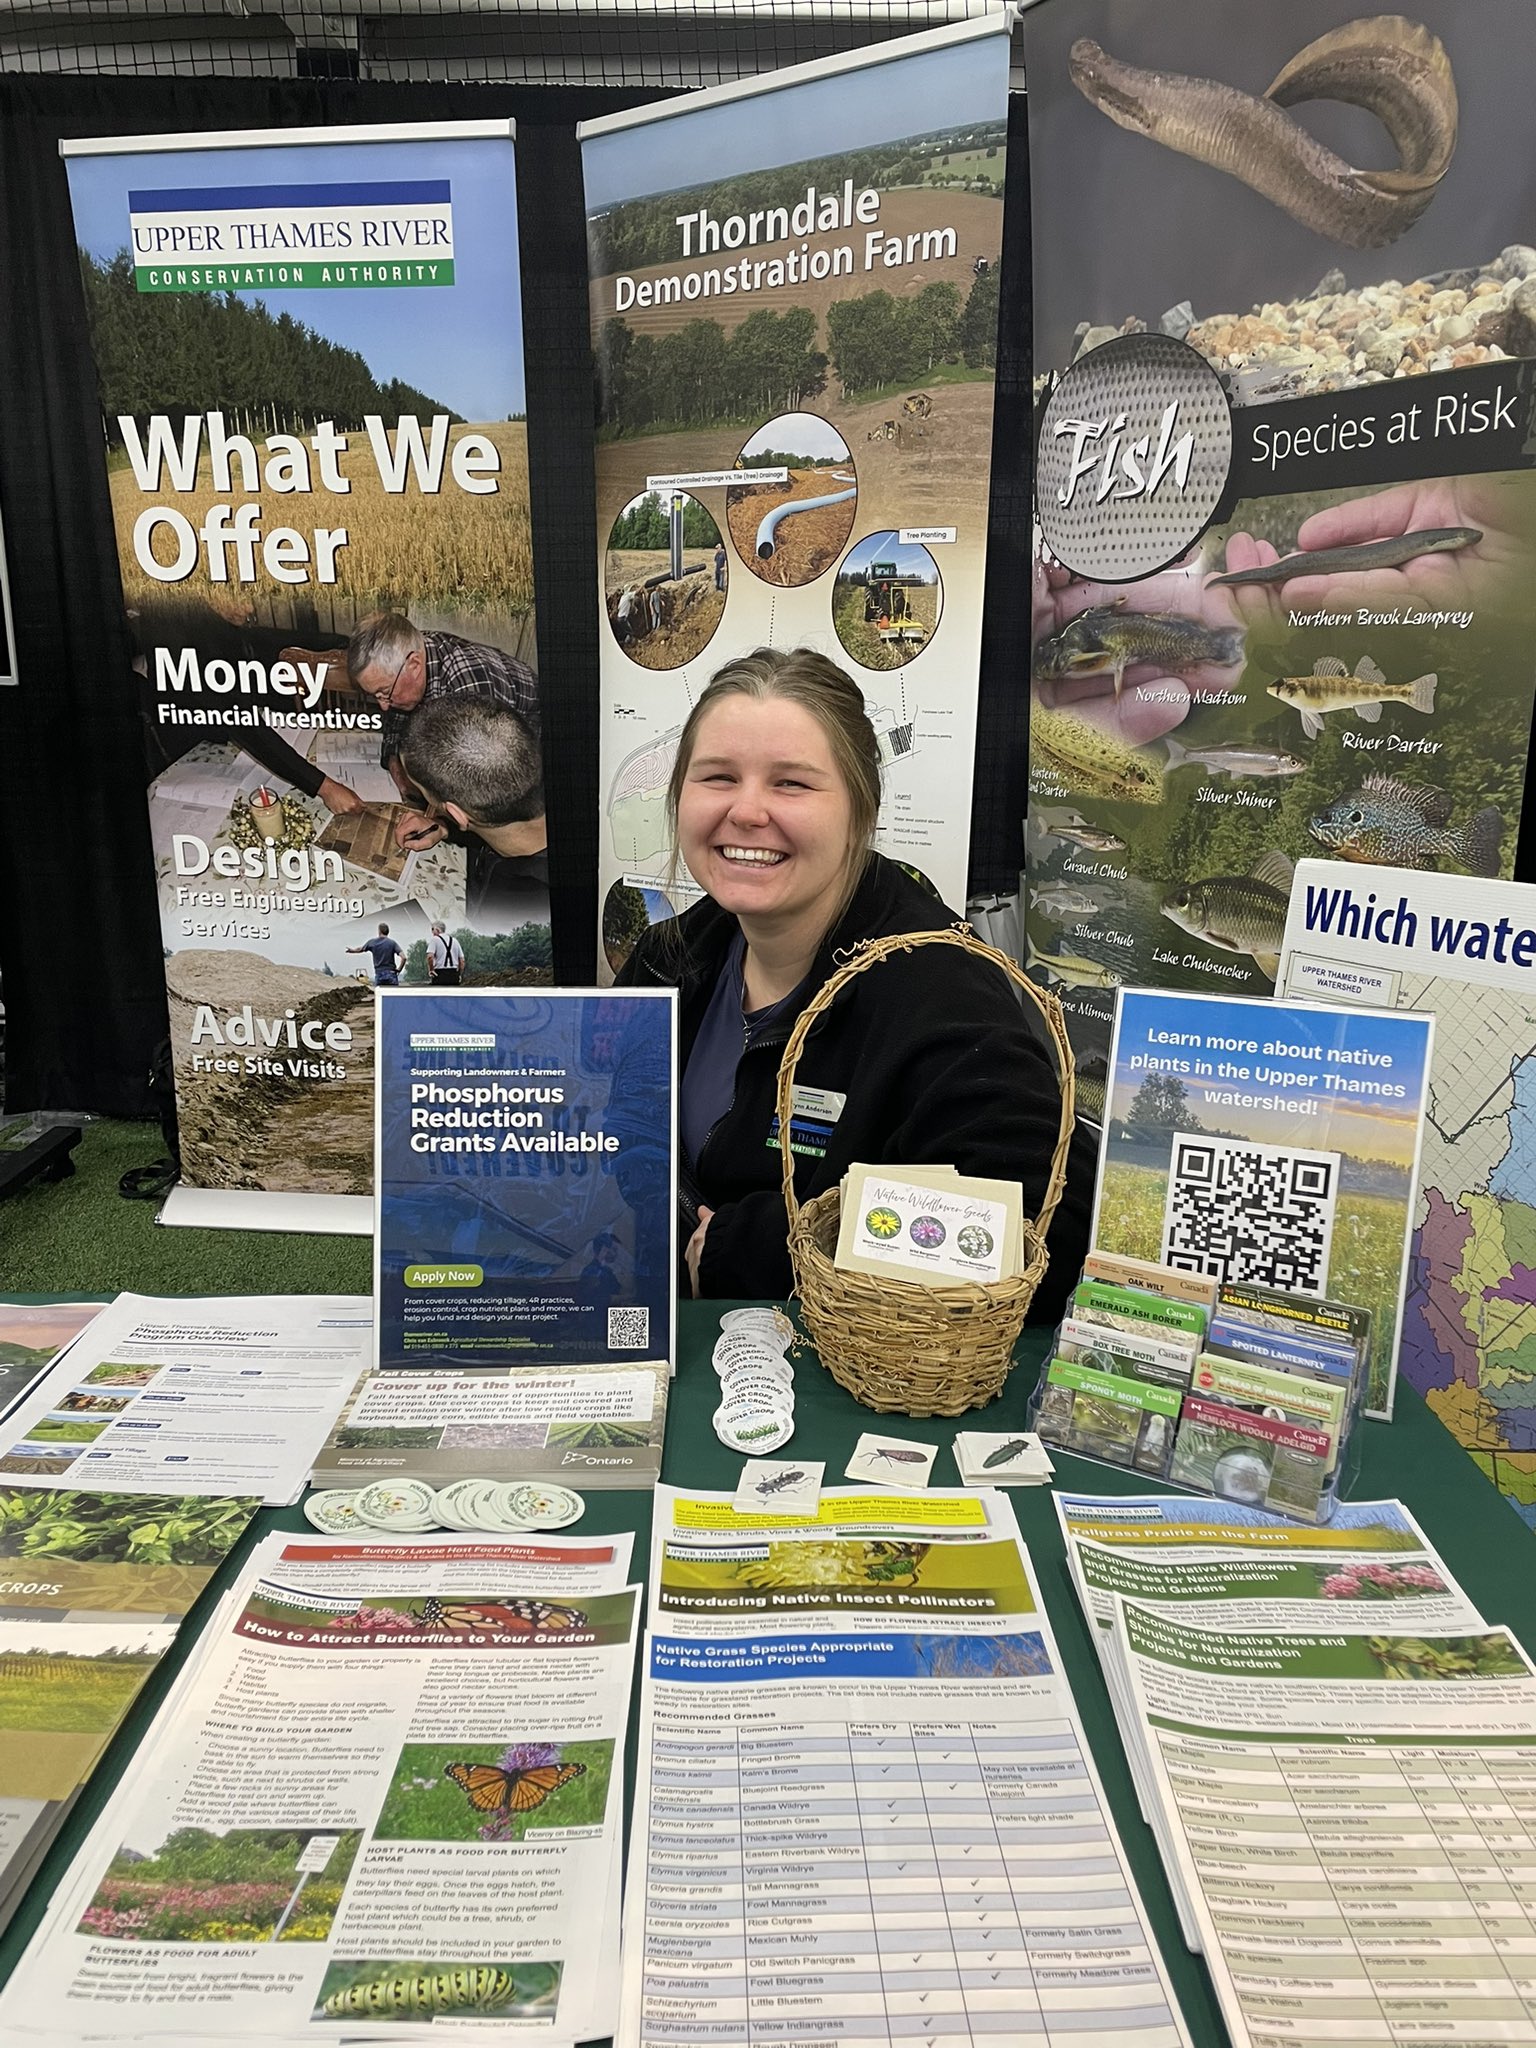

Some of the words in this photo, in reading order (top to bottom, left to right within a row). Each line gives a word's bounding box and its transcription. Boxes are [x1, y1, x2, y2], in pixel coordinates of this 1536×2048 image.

[676, 179, 881, 258] Thorndale
[133, 225, 224, 254] UPPER
[231, 221, 353, 250] THAMES
[362, 218, 451, 246] RIVER
[150, 267, 304, 286] CONSERVATION
[322, 264, 439, 282] AUTHORITY
[615, 244, 854, 311] Demonstration
[864, 226, 958, 271] Farm
[1251, 414, 1376, 470] Species
[1389, 403, 1421, 444] at
[1434, 386, 1517, 438] Risk
[117, 411, 351, 493] What
[364, 414, 501, 495] We
[1053, 400, 1195, 508] Fish
[133, 503, 348, 584] Offer
[920, 531, 947, 540] Planting
[1288, 609, 1352, 628] Northern
[1356, 607, 1401, 626] Brook
[1403, 607, 1474, 630] Lamprey
[154, 647, 329, 708] Money
[1135, 686, 1191, 705] Northern
[1193, 689, 1247, 705] Madtom
[158, 704, 260, 727] Financial
[264, 707, 382, 730] Incentives
[1342, 731, 1384, 751] River
[1387, 735, 1443, 755] Darter
[1032, 764, 1059, 779] Eastern
[1040, 782, 1070, 797] Darter
[1196, 787, 1232, 804] Silver
[1234, 791, 1277, 809] Shiner
[172, 834, 345, 891] Design
[1064, 858, 1098, 876] Gravel
[1100, 864, 1128, 880] Chub
[177, 888, 226, 908] Free
[231, 891, 365, 917] Engineering
[1305, 885, 1417, 948] Which
[181, 919, 271, 940] Services
[1074, 924, 1103, 940] Silver
[1106, 930, 1134, 947] Chub
[1152, 948, 1179, 965] Lake
[1181, 953, 1252, 981] Chubsucker
[1302, 966, 1326, 977] UPPER
[1328, 970, 1357, 983] THAMES
[1359, 977, 1382, 988] RIVER
[1317, 978, 1362, 994] WATERSHED
[191, 1006, 354, 1050] Advice
[1148, 1027, 1201, 1047] Learn
[1206, 1036, 1258, 1053] more
[1262, 1038, 1322, 1059] about
[1327, 1047, 1393, 1069] native
[192, 1055, 239, 1074] Free
[244, 1057, 282, 1076] Site
[283, 1059, 347, 1080] Visits
[410, 1068, 462, 1078] Supporting
[464, 1068, 519, 1076] Landowners
[1130, 1053, 1191, 1075] plants
[1195, 1058, 1213, 1075] in
[1218, 1060, 1250, 1080] the
[1255, 1066, 1318, 1092] Upper
[1322, 1073, 1406, 1099] Thames
[411, 1082, 564, 1107] Phosphorus
[1204, 1088, 1318, 1116] watershed!
[411, 1107, 542, 1128] Reduction
[806, 1105, 832, 1115] Anderson
[410, 1132, 496, 1152] Grants
[501, 1132, 620, 1152] Available
[874, 1188, 906, 1203] Native
[908, 1192, 961, 1213] Wildflower
[964, 1206, 992, 1222] Seeds
[412, 1271, 445, 1283] Apply
[449, 1271, 475, 1281] Now
[1128, 1278, 1144, 1288] OAK
[1147, 1282, 1165, 1292] WILT
[1179, 1281, 1209, 1294] Canada
[1090, 1299, 1130, 1314] EMERALD
[1132, 1308, 1150, 1319] ASH
[1152, 1313, 1182, 1327] BORER
[1166, 1307, 1195, 1321] Canada
[1222, 1295, 1250, 1308] ASIAN
[1251, 1302, 1313, 1322] LONGHORNED
[1315, 1315, 1350, 1330] BEETLE
[1317, 1306, 1350, 1322] Canada
[135, 1327, 210, 1335] Phosphorus
[1093, 1340, 1109, 1350] BOX
[1111, 1344, 1131, 1356] TREE
[1132, 1350, 1156, 1362] MOTH
[1158, 1348, 1188, 1362] Canada
[1231, 1339, 1269, 1356] SPOTTED
[1271, 1348, 1326, 1370] LANTERNFLY
[372, 1382, 423, 1391] Cover
[453, 1380, 477, 1390] for
[482, 1381, 511, 1390] the
[515, 1380, 575, 1389] winter!
[1080, 1381, 1115, 1397] SPONGY
[1117, 1392, 1143, 1405] MOTH
[1146, 1389, 1176, 1405] Canada
[727, 1412, 748, 1423] COVER
[749, 1408, 775, 1416] CROPS
[1197, 1412, 1238, 1431] HEMLOCK
[1240, 1424, 1276, 1441] WOOLLY
[1277, 1435, 1317, 1452] ADELGID
[1293, 1430, 1327, 1446] Canada
[586, 1457, 633, 1465] Ontario
[1072, 1526, 1140, 1539] Tallgrass
[1144, 1529, 1195, 1539] Prairie
[1199, 1530, 1217, 1538] on
[1222, 1530, 1245, 1538] the
[1250, 1532, 1289, 1540] Farm
[0, 1582, 63, 1596] CROPS
[662, 1593, 767, 1608] Introducing
[772, 1594, 830, 1605] Native
[837, 1593, 894, 1604] Insect
[899, 1594, 996, 1607] Pollinators
[243, 1621, 282, 1638] How
[287, 1631, 304, 1642] to
[308, 1633, 370, 1644] Attract
[375, 1634, 463, 1644] Butterflies
[469, 1634, 486, 1644] to
[491, 1634, 524, 1644] Your
[527, 1633, 596, 1643] Garden
[1126, 1606, 1225, 1645] Recommended
[1228, 1634, 1271, 1646] Native
[1274, 1636, 1315, 1647] Trees
[1320, 1636, 1348, 1647] and
[656, 1644, 700, 1657] Native
[704, 1644, 747, 1656] Grass
[751, 1642, 807, 1655] Species
[811, 1641, 894, 1653] Appropriate
[1129, 1620, 1175, 1644] Shrubs
[1178, 1638, 1198, 1650] for
[1201, 1642, 1301, 1658] Naturalization
[656, 1654, 676, 1666] for
[680, 1655, 763, 1668] Restoration
[767, 1653, 826, 1666] Projects
[1131, 1634, 1188, 1660] Projects
[1190, 1653, 1217, 1667] and
[1220, 1656, 1283, 1670] Gardens
[748, 1935, 787, 1945] Mexican
[791, 1934, 819, 1946] Muhly
[1031, 1951, 1072, 1961] Formerly
[1075, 1948, 1131, 1960] Switchgrass
